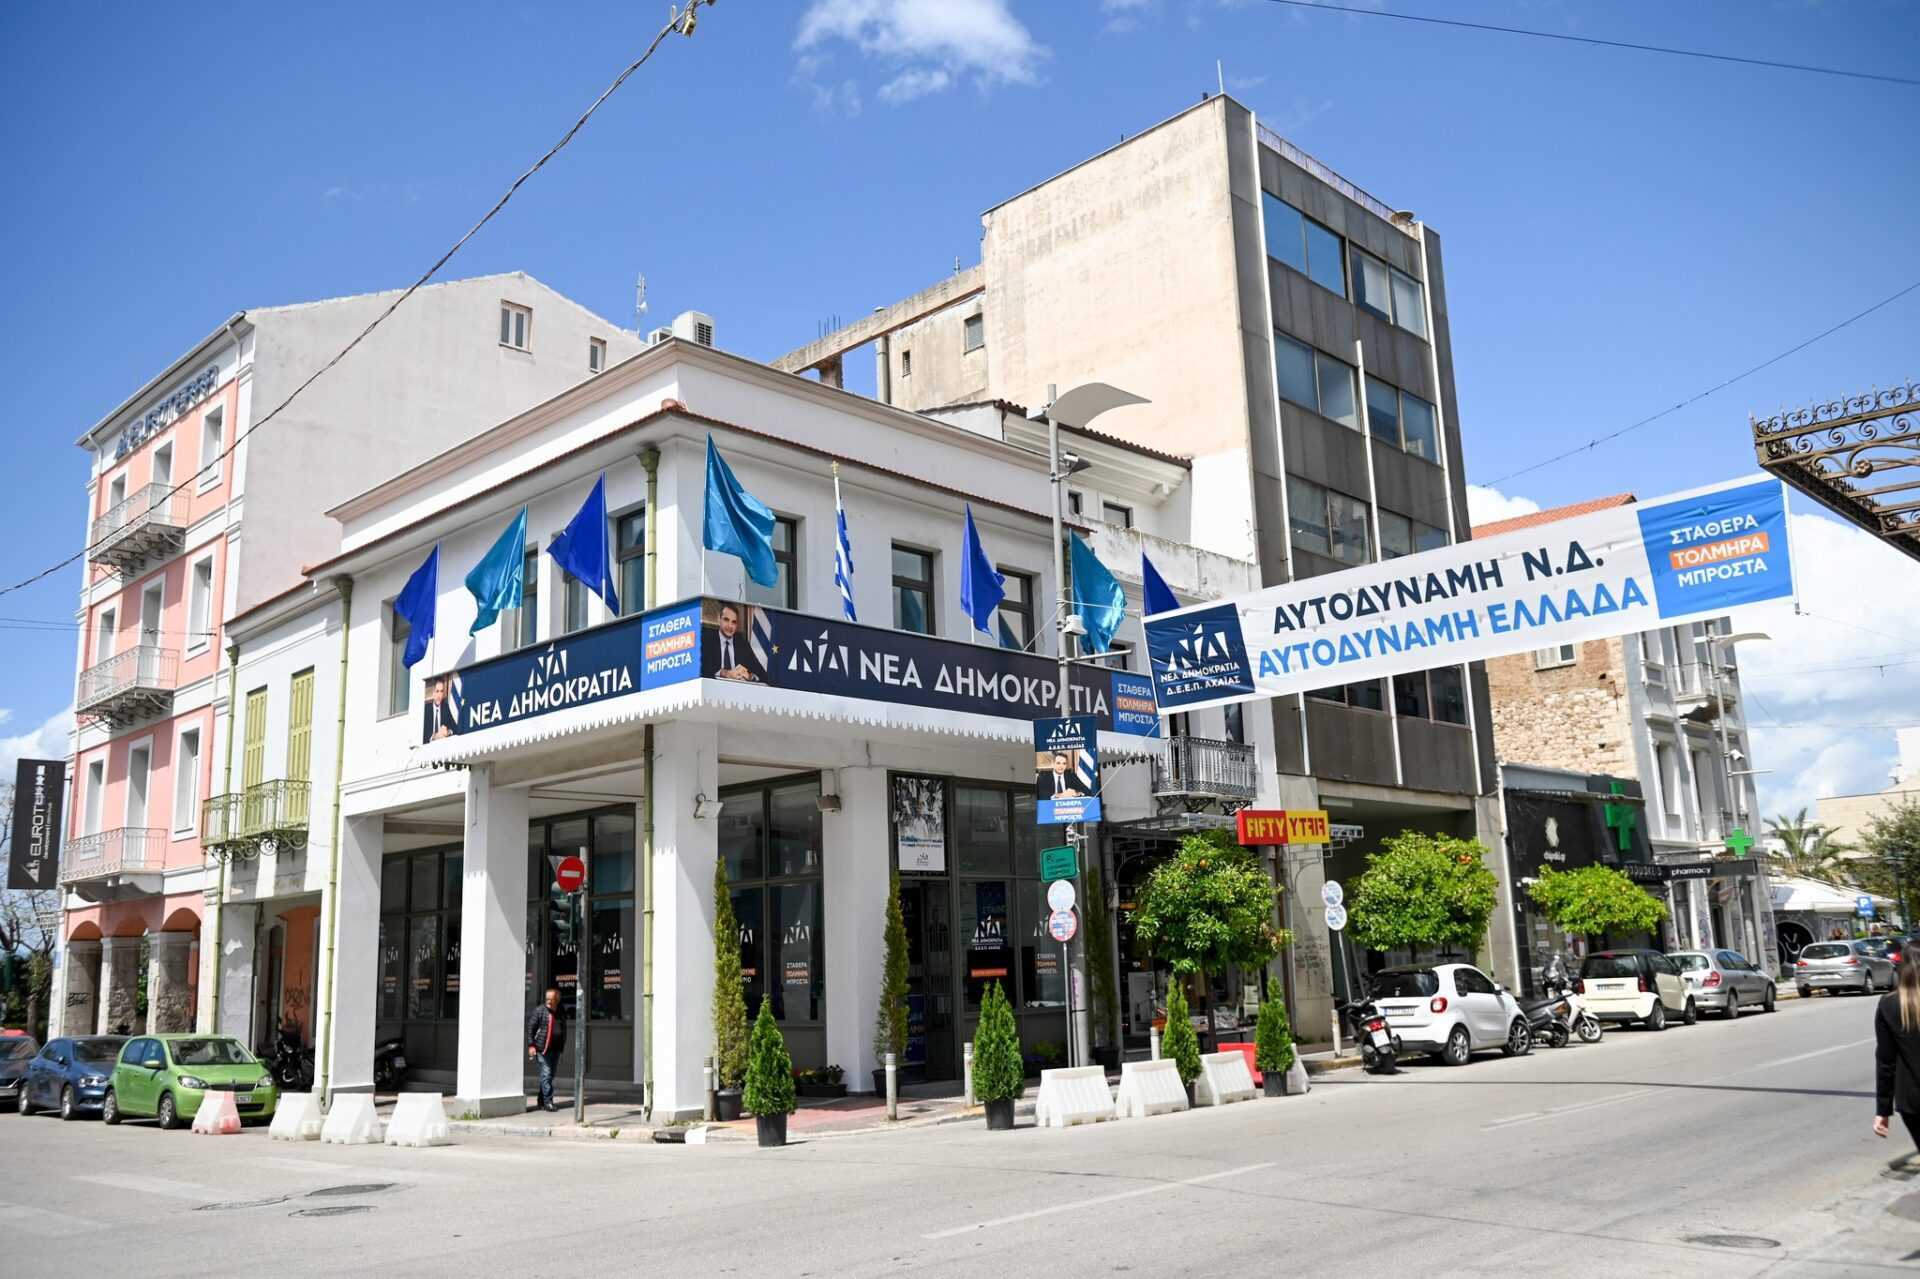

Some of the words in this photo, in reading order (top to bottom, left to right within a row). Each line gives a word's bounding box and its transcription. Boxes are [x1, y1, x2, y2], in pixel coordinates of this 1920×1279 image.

[1670, 514, 1758, 545] ΣΤΑΘΕΡΑ
[1673, 536, 1764, 566] ΤΟΛΜΗΡΑ
[1677, 558, 1768, 588] ΜΠΡΟΣΤΑ
[1274, 558, 1504, 634] ΑΥΤΟΔΥΝΑΜΗ
[1522, 540, 1604, 581] Ν.Δ.
[649, 616, 692, 638] ΣΤΑΘΕΡΑ
[1258, 610, 1480, 678] ΑΥΤΟΔΥΝΑΜΗ
[1487, 576, 1648, 634] ΕΛΛΑΔΑ
[647, 635, 692, 657] ΤΟΛΜΗΡΑ
[647, 652, 692, 674] ΜΠΡΟΣΤΑ
[860, 649, 923, 689] ΝΕΑ
[1160, 671, 1180, 683] ΝΕΑ
[1182, 662, 1240, 678] ΔΗΜΟΚΡΑΤΙΑ
[469, 700, 502, 728] ΝΕΑ
[508, 666, 632, 718] ΔΗΜΟΚΡΑΤΙΑ
[1118, 683, 1152, 696] ΣΤΑΘΕΡΑ
[1119, 712, 1154, 725] ΜΠΡΟΣΤΑ
[1246, 818, 1285, 838] FIFTY
[1671, 867, 1711, 877] pharmacy
